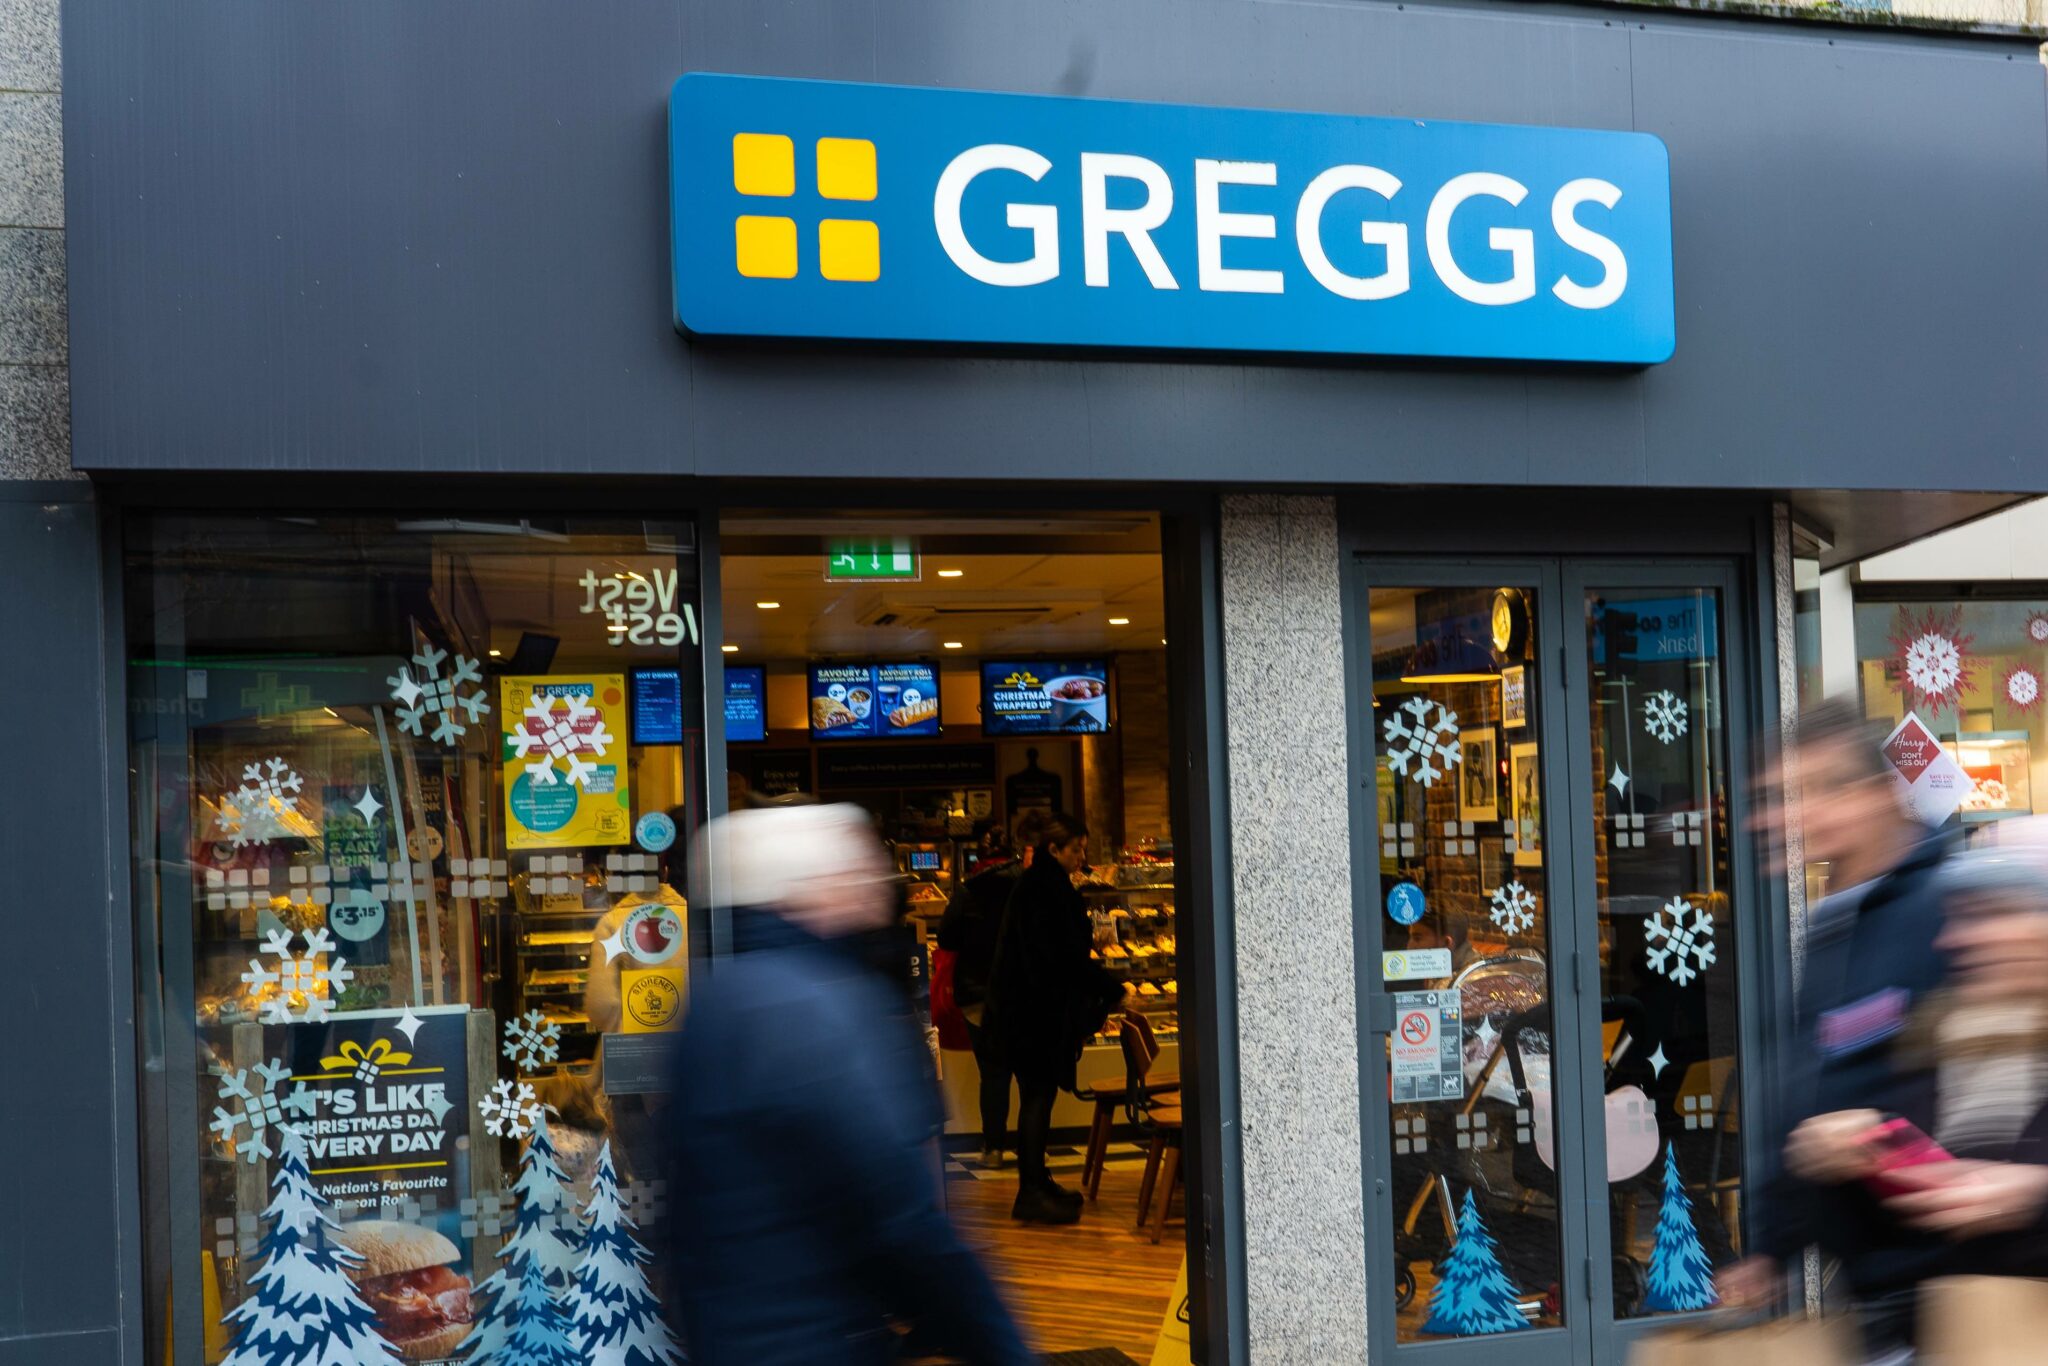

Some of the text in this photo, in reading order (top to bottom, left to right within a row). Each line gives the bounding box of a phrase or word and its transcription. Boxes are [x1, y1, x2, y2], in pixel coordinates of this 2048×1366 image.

[933, 143, 1628, 310] GREGGS
[817, 669, 861, 678] SAVOURY
[546, 685, 593, 696] GREGGS
[993, 690, 1052, 702] CHRISTMAS
[993, 700, 1053, 711] WRAPPED UP
[1893, 732, 1930, 752] Hurry!
[1895, 759, 1929, 767] MISS OUT
[763, 768, 784, 782] Enjoy
[343, 840, 380, 853] ANY
[329, 854, 382, 868] DRINK
[1395, 1048, 1408, 1057] NO
[365, 1082, 446, 1113] LIKE
[391, 1130, 447, 1154] DAY
[321, 1181, 380, 1196] Nation's
[382, 1175, 448, 1190] Favourite
